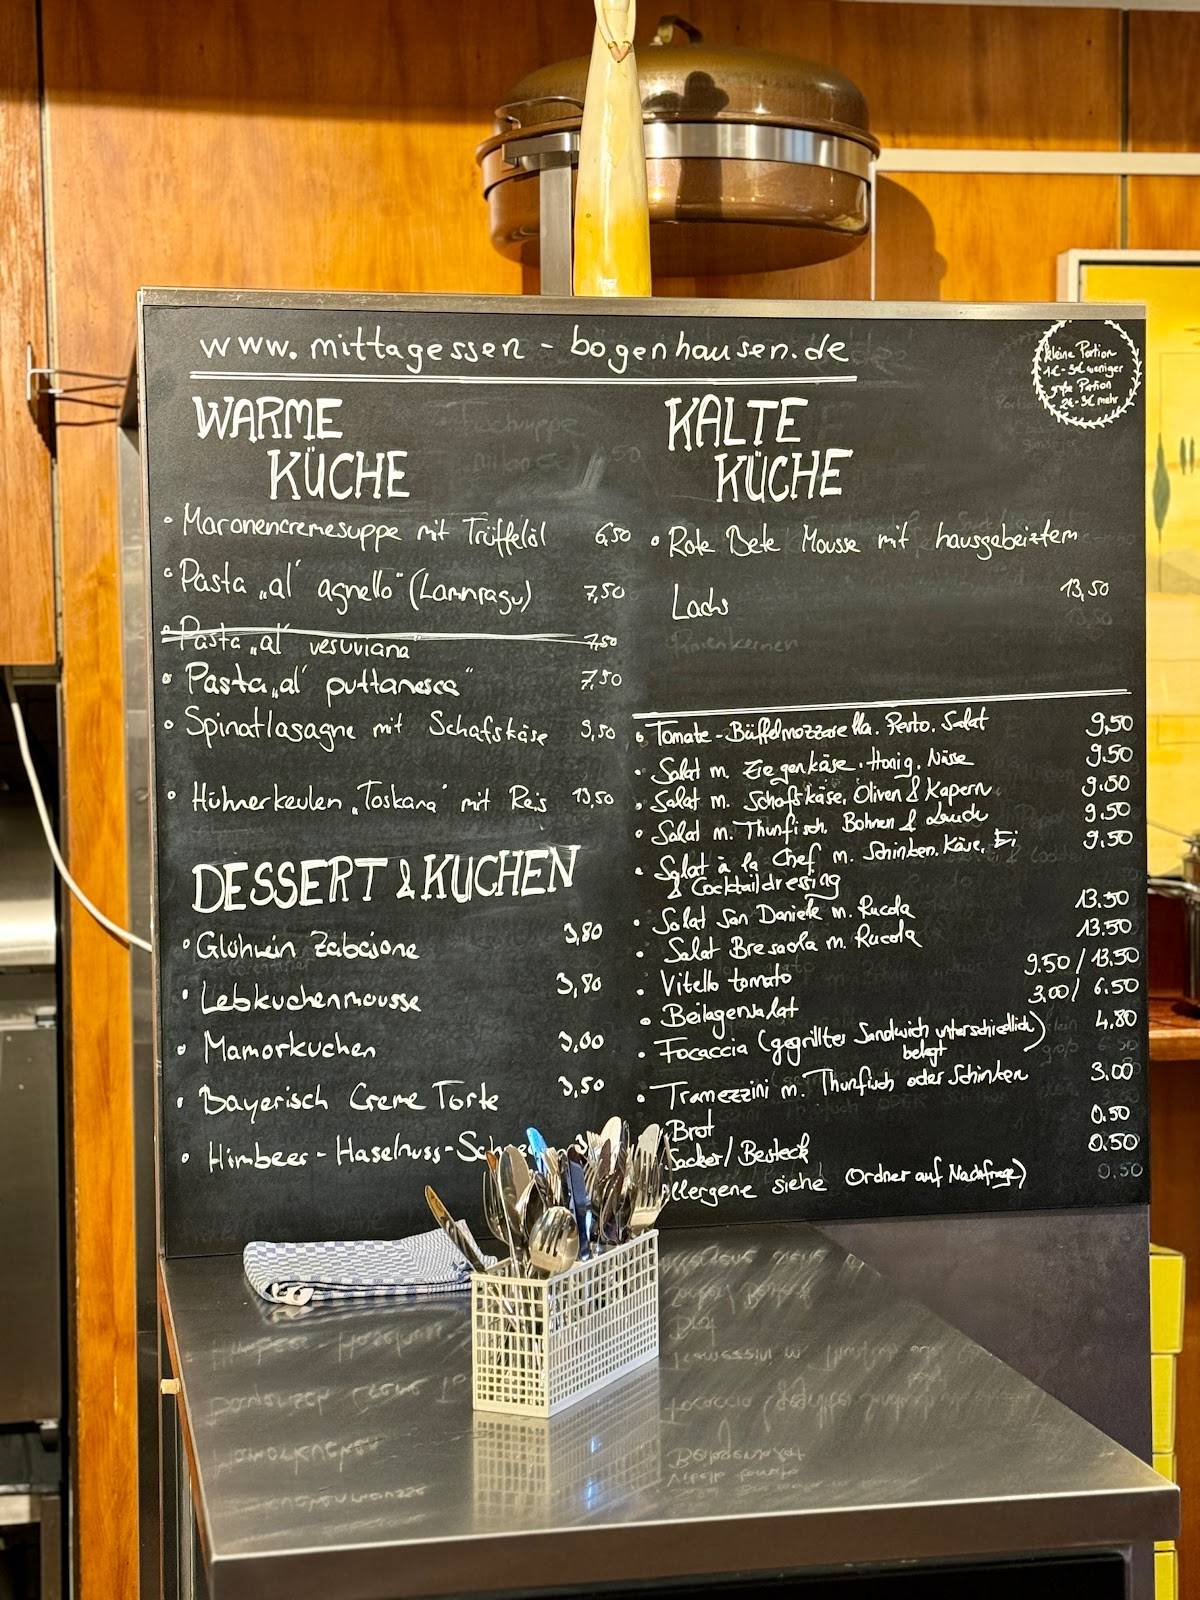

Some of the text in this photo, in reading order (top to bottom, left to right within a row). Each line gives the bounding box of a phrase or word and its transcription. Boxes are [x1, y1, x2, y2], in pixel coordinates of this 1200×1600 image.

[192, 396, 343, 442] WARME
[664, 394, 808, 452] KALTE
[267, 446, 410, 500] KÜCHE
[714, 448, 854, 503] KÜCHE
[183, 503, 632, 558] Maronencremesuppe mit Trüffelöl 6,50
[668, 525, 715, 558] Rote
[726, 524, 781, 557] Bete
[878, 520, 909, 549] mit
[180, 557, 247, 594] Pasta
[583, 582, 626, 604] 7,50
[1059, 578, 1110, 602] 13,50
[672, 583, 729, 620] Lachs
[179, 615, 241, 651] Pasta
[185, 661, 268, 695] Pasta
[581, 669, 622, 690] 7,50
[184, 705, 357, 753] Spinatlasagne
[373, 712, 403, 738] mit
[429, 710, 549, 747] Schafskäse
[941, 706, 989, 732] Salat
[650, 757, 700, 785] Salat
[192, 780, 342, 812] Hühnerkeulen
[460, 787, 491, 813] mit
[509, 784, 548, 813] Reis
[650, 785, 700, 813] Salat
[906, 775, 920, 802] &
[925, 777, 992, 806] Kapern
[651, 819, 701, 845] Salat
[842, 811, 895, 833] Bohnen
[899, 808, 917, 832] &
[191, 844, 582, 914] DESSERT & KUCHEN
[654, 852, 710, 880] Salat
[741, 852, 758, 872] la
[772, 842, 822, 875] Chef
[564, 921, 603, 947] 3,80
[652, 905, 706, 935] Salat
[716, 908, 748, 929] San
[756, 898, 823, 925] Daniele
[857, 894, 916, 920] Rucola
[664, 935, 721, 964] Salat
[729, 931, 818, 959] Bresaola
[854, 918, 924, 949] Rucola
[201, 972, 602, 1015] Lebkuchenmousse 3,80
[660, 968, 720, 997] Vitello
[660, 996, 799, 1040] Beilagensalat
[203, 1029, 377, 1064] Mamorkuchen
[653, 1036, 749, 1064] Focaccia
[853, 1016, 930, 1045] Sandwich
[902, 1039, 949, 1068] belegt
[198, 1075, 605, 1125] Bayerisch Creme Torte 3,50
[649, 1078, 770, 1111] Tramezzini
[802, 1066, 895, 1097] Thunfisch
[906, 1068, 944, 1088] oder
[948, 1060, 1029, 1086] Schinken
[665, 1108, 715, 1143] Brot
[771, 1172, 828, 1195] siehe
[845, 1163, 911, 1186] Ordner
[915, 1155, 943, 1189] auf
